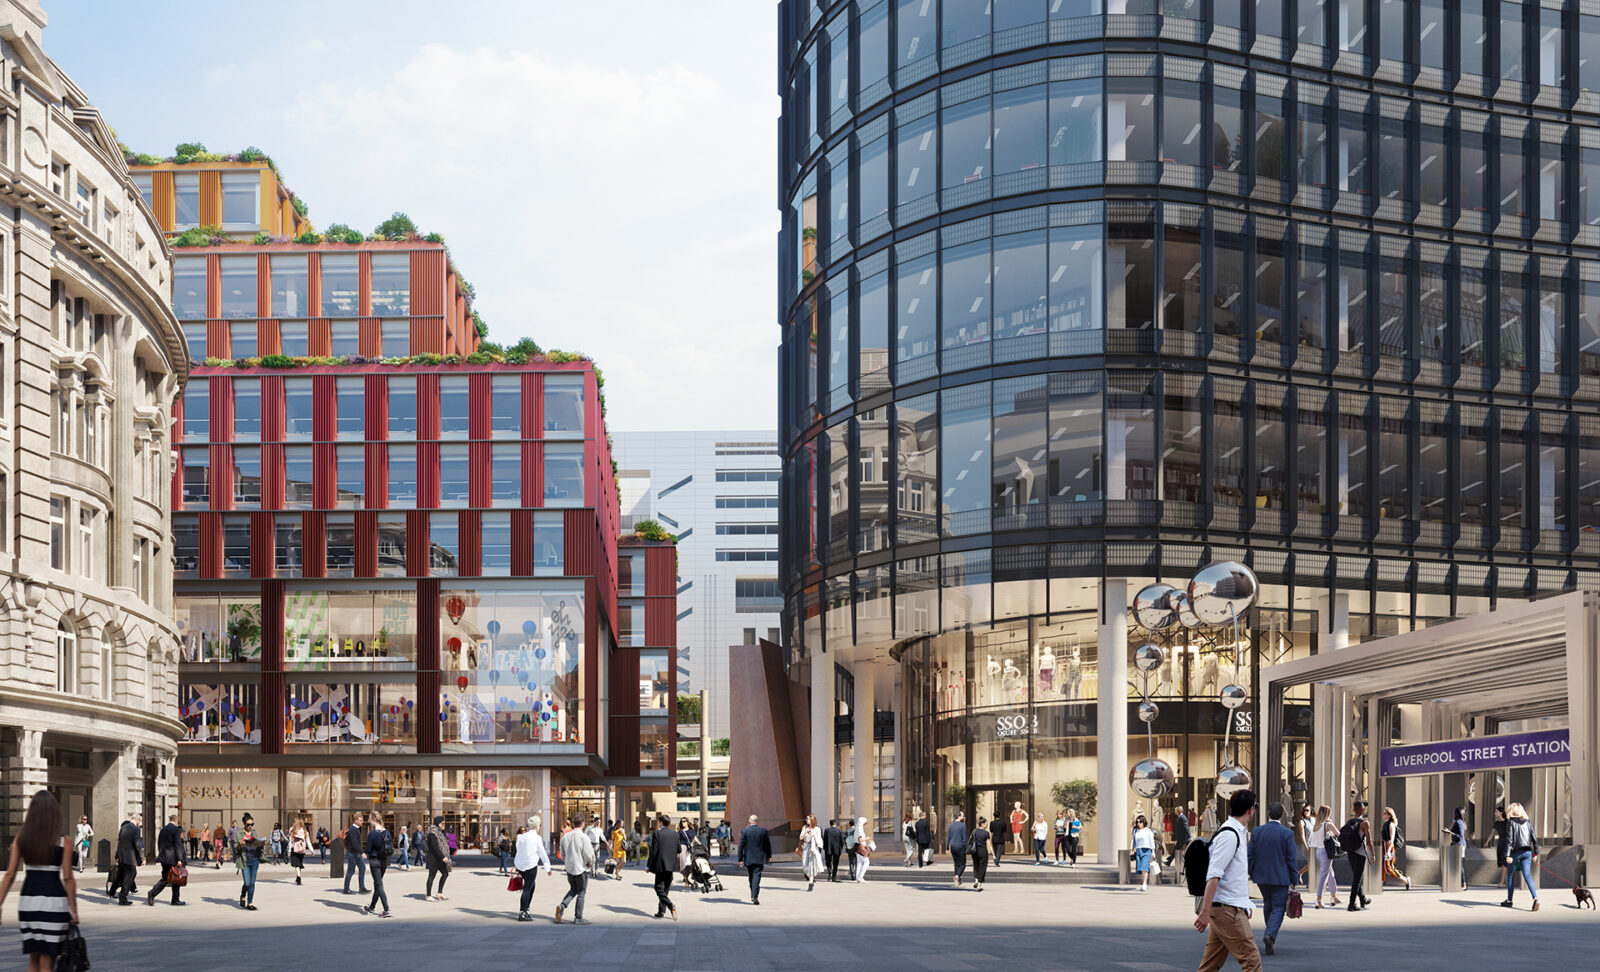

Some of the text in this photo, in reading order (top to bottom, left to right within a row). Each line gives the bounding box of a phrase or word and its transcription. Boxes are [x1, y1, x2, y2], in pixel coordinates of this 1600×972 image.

[1393, 740, 1570, 767] LIVERPOOL STREET STATION
